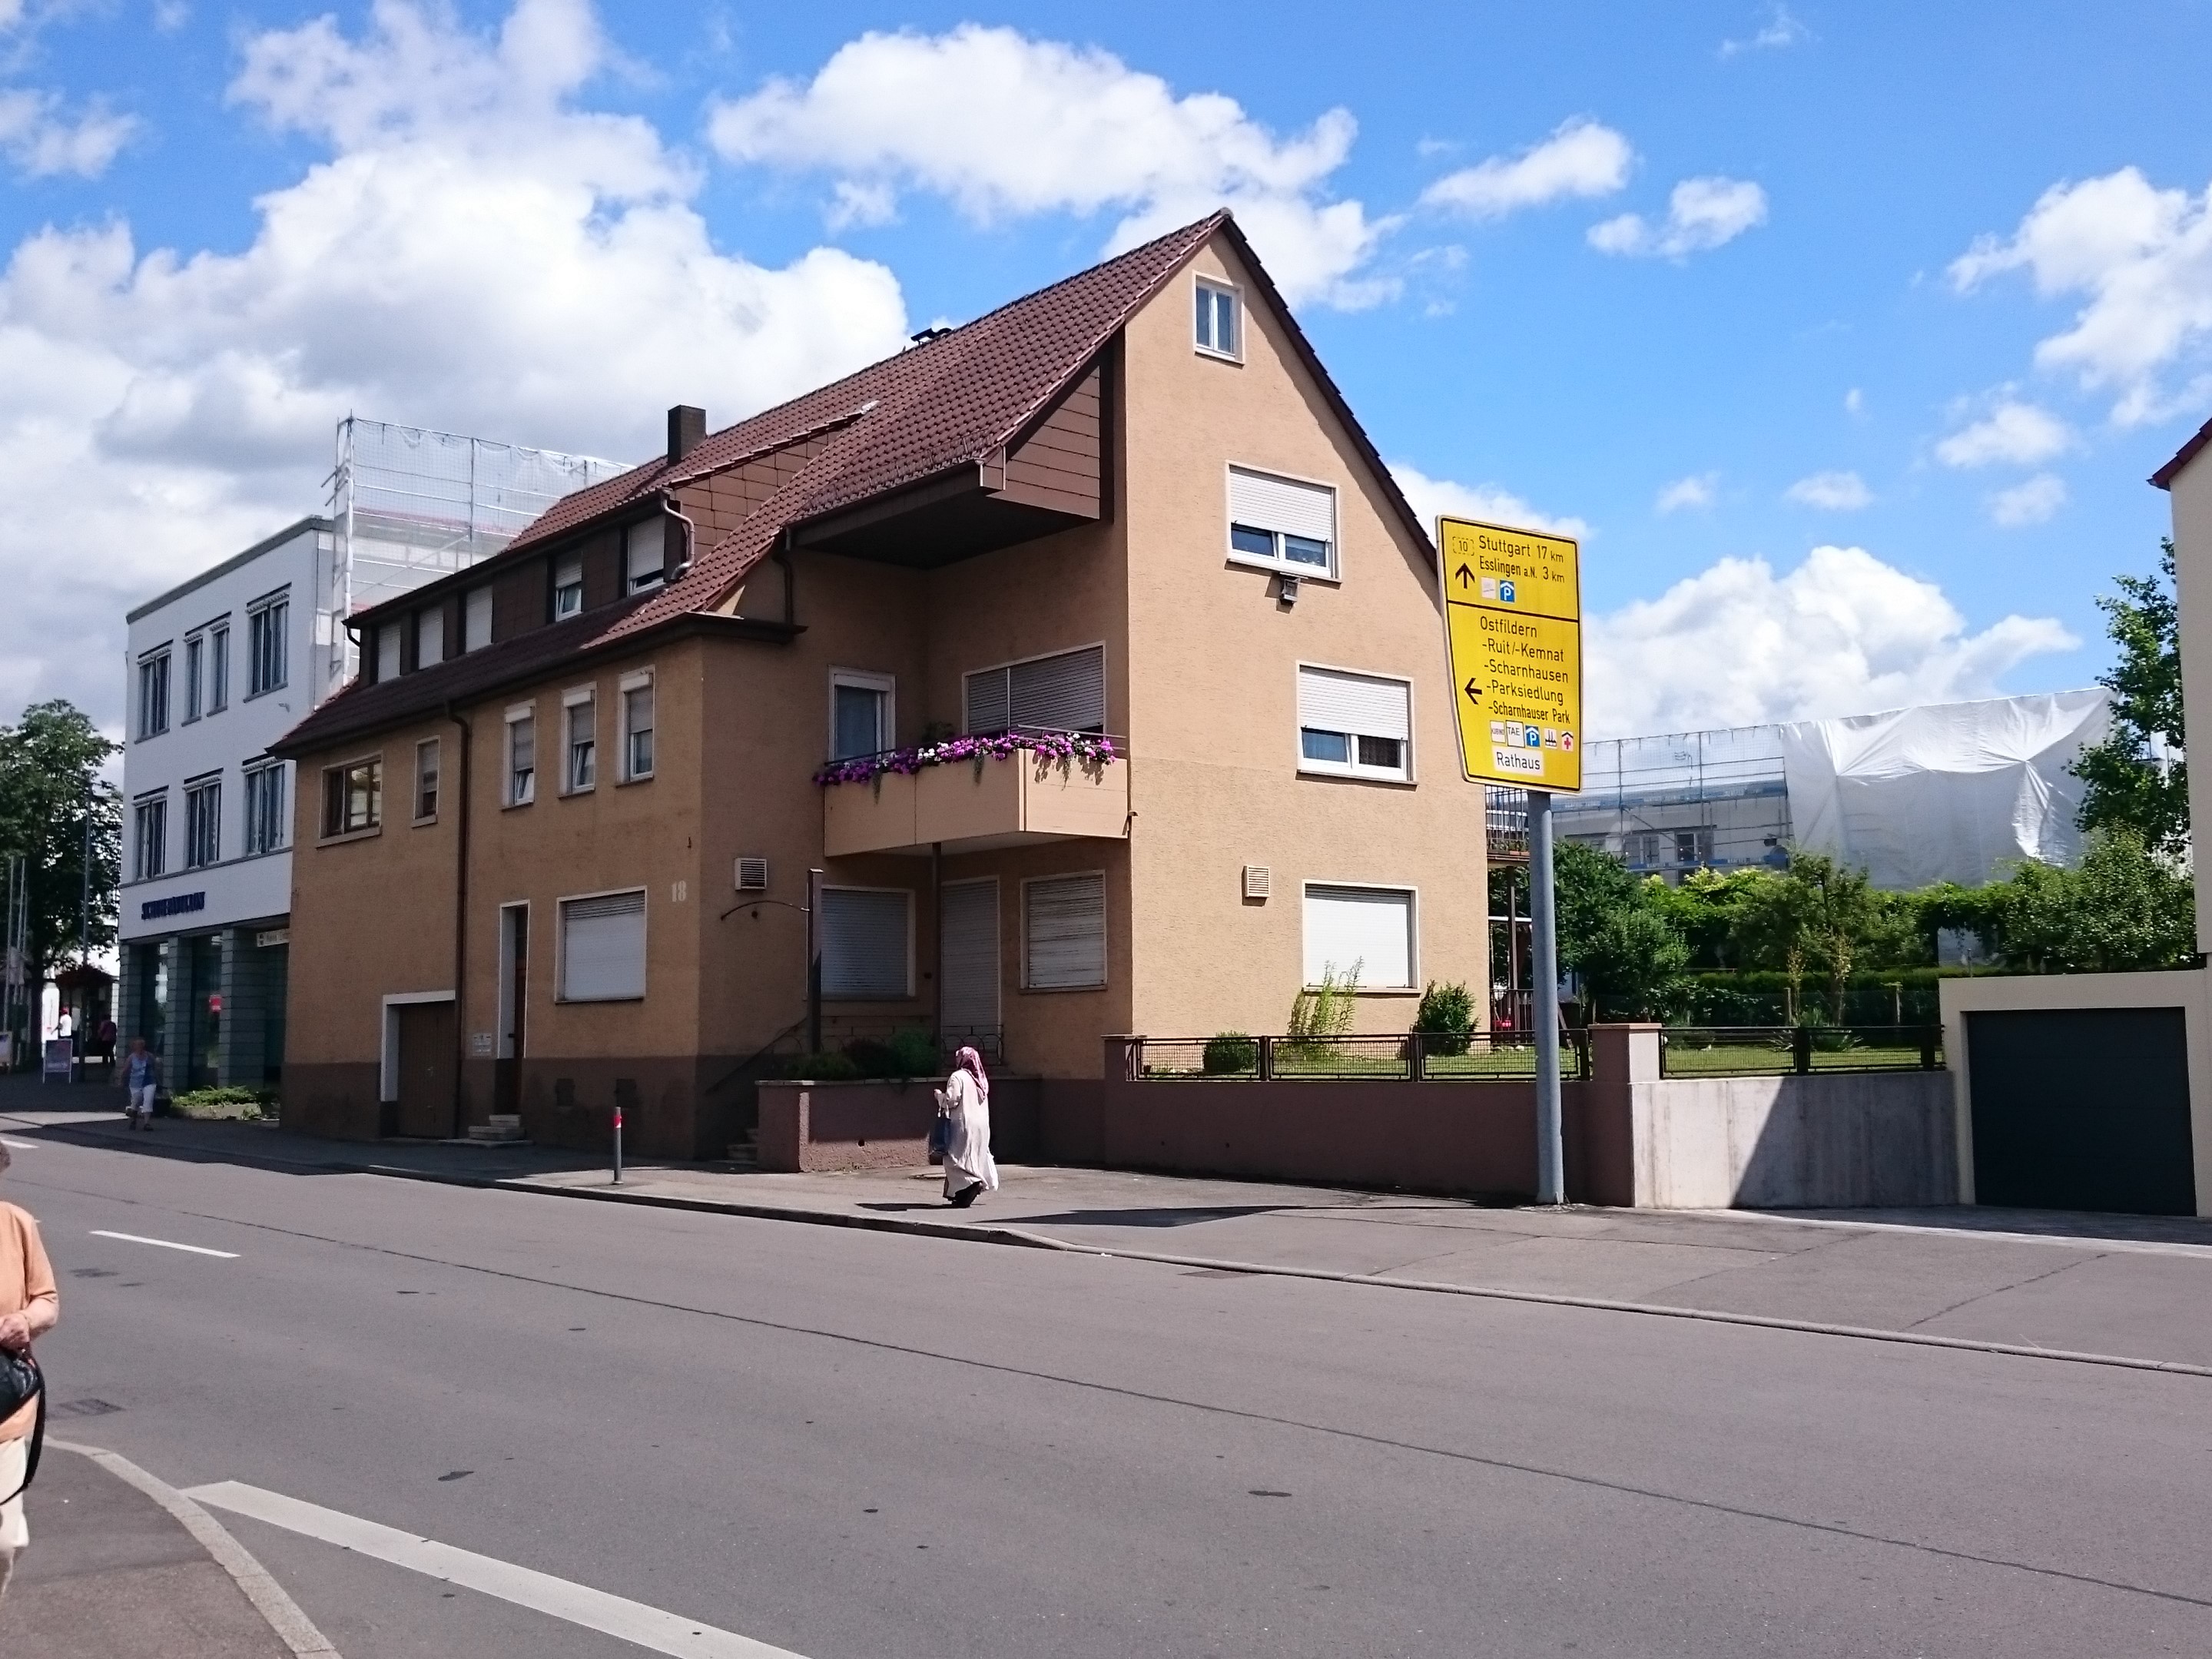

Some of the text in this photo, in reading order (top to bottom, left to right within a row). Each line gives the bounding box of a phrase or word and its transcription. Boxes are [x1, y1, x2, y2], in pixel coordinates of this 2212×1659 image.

[1459, 540, 1468, 552] 10
[1479, 535, 1564, 563] Stuttgart 17 km
[1479, 556, 1565, 583] Esslingen a.N. 3 km
[1480, 615, 1537, 638] Ostfildern
[1484, 659, 1569, 683] -Scharnhausen
[1487, 679, 1564, 706] -Parksiedlung
[1488, 700, 1570, 724] -Scharnhauser Park
[1506, 726, 1521, 736] TAE
[1496, 752, 1540, 770] Rathaus
[672, 880, 687, 902] 18
